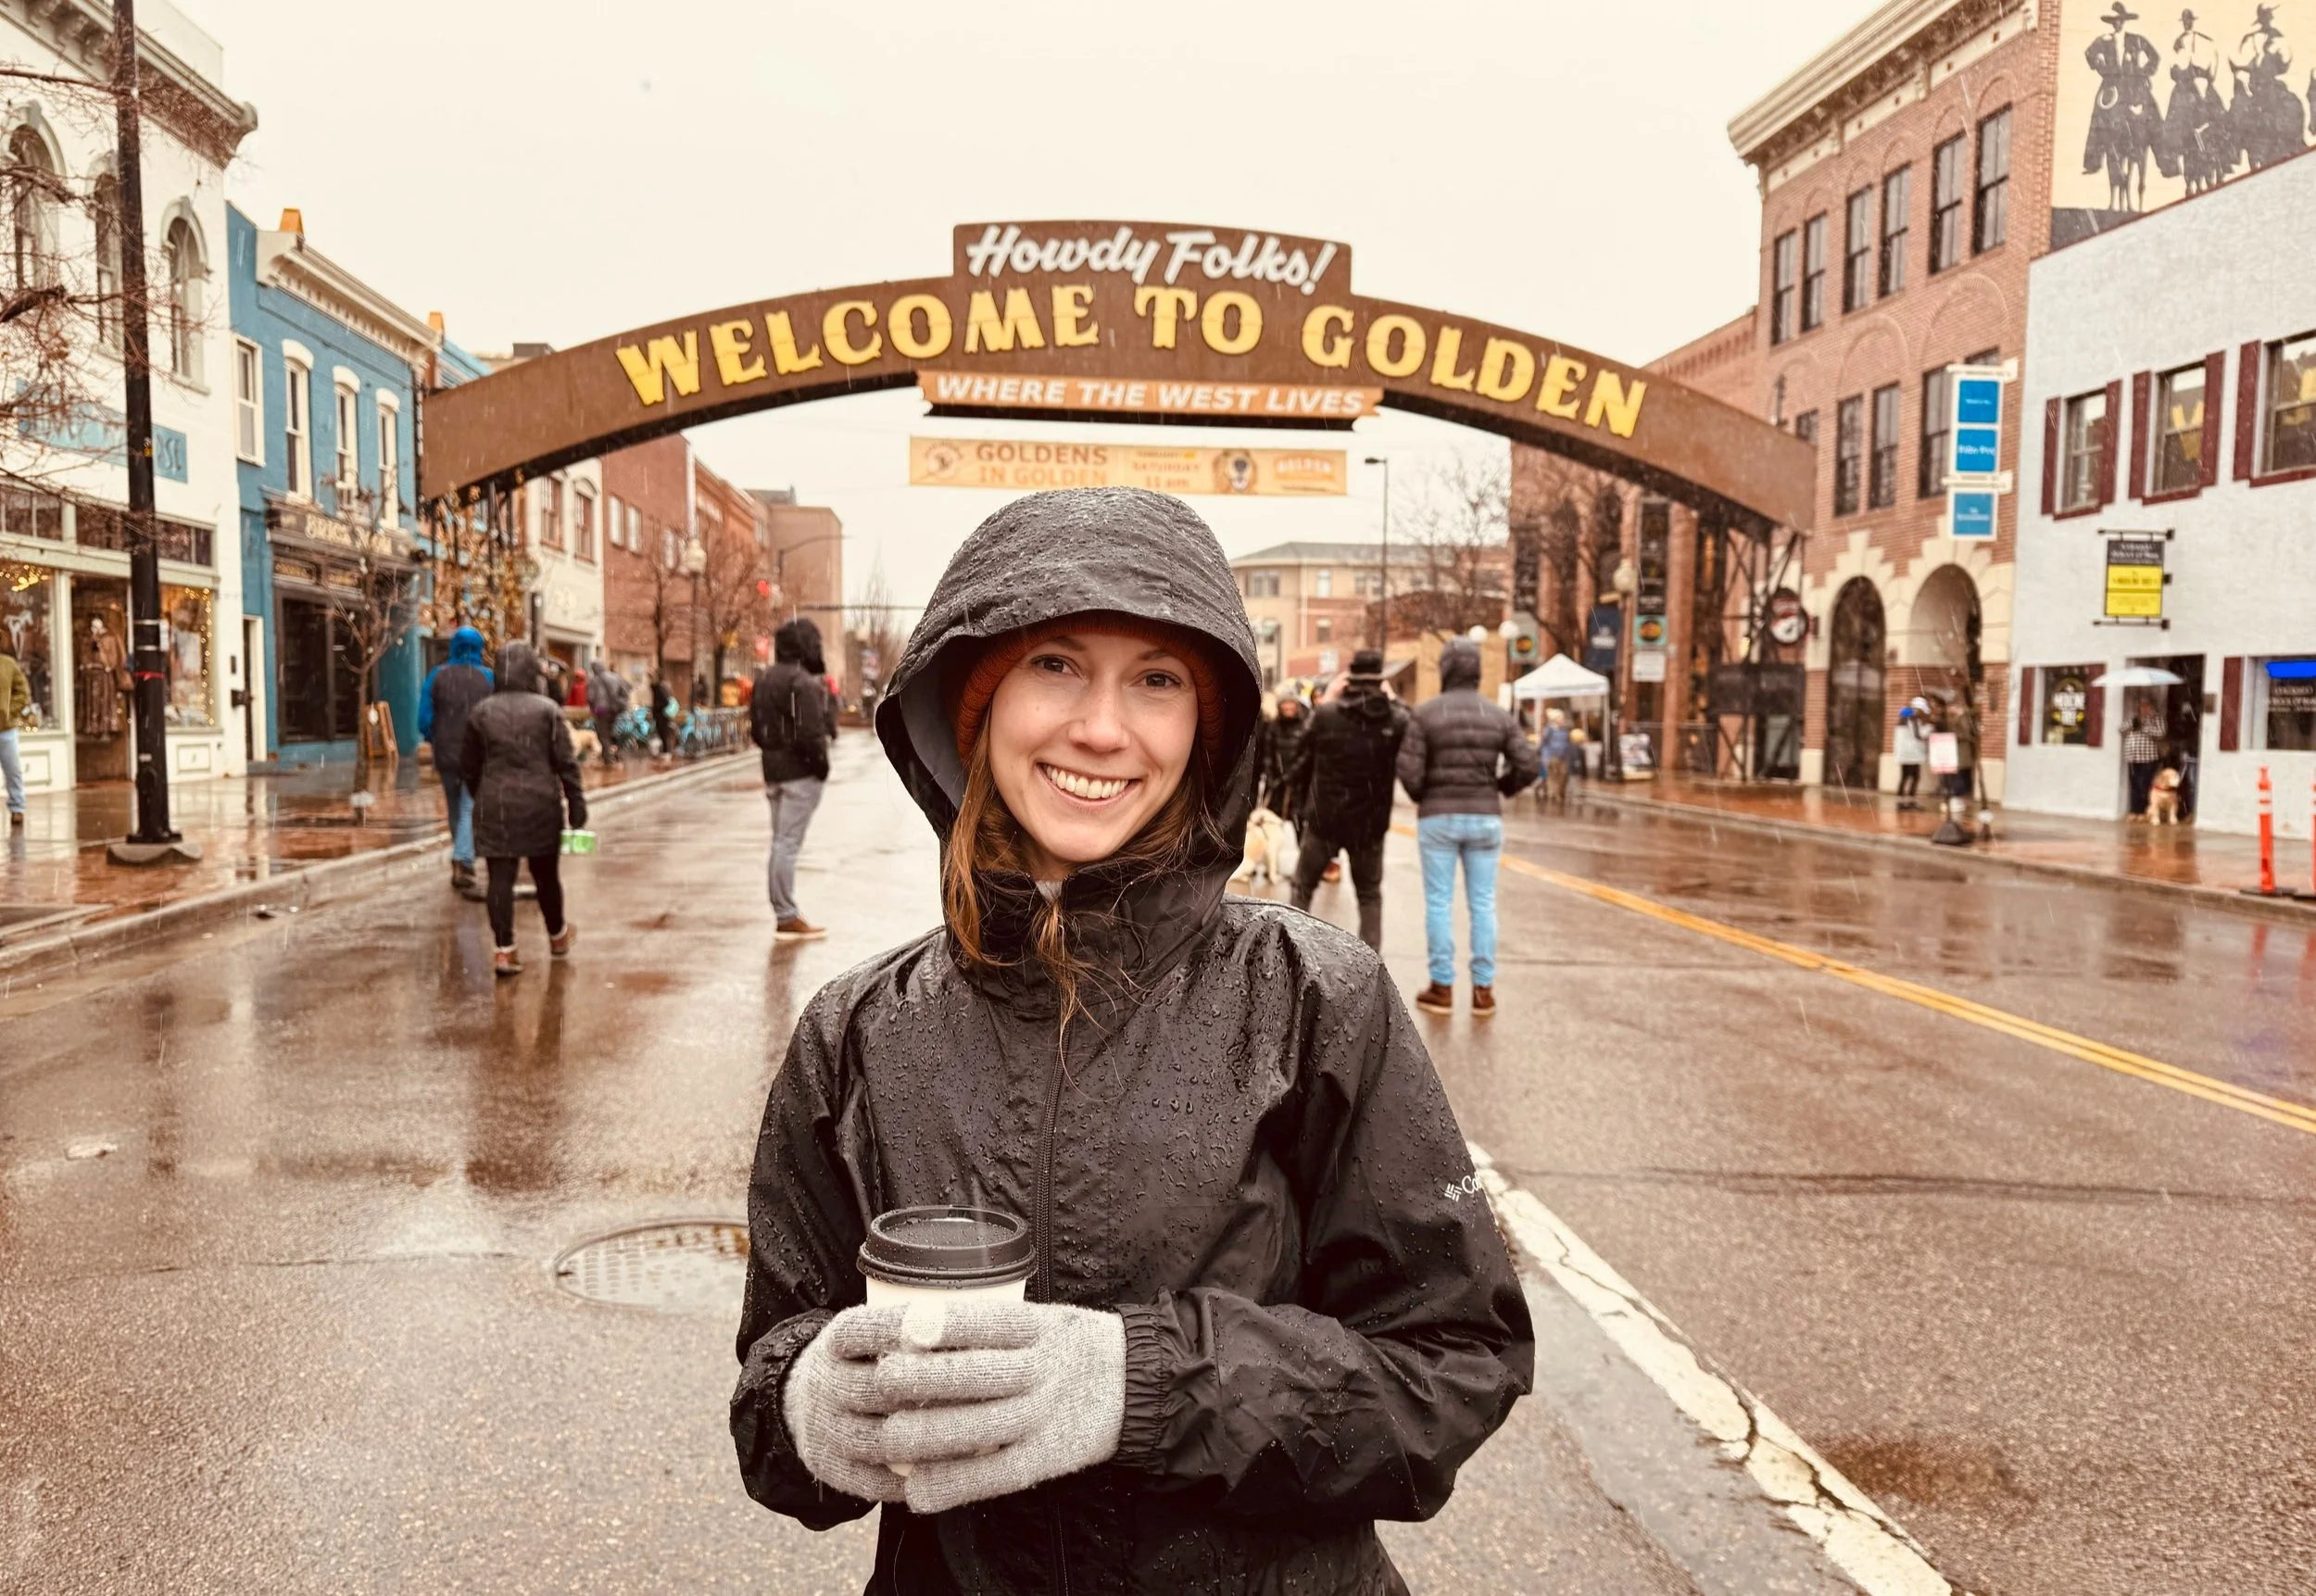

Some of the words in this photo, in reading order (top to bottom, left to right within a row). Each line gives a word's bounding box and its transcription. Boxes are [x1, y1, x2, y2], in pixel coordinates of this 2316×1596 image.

[966, 225, 1161, 284] Howdy
[1164, 230, 1338, 295] Folks!
[615, 284, 1100, 407] WELCOME
[1133, 285, 1264, 356] TO
[1302, 304, 1647, 439] GOLDEN
[937, 372, 1067, 405] WHERE
[1077, 381, 1147, 408] THE
[1158, 384, 1259, 411] WEST
[1265, 387, 1365, 415] LIVES
[976, 442, 1108, 465] GOLDENS
[978, 466, 1006, 484] IN
[1013, 467, 1107, 486] GOLDEN
